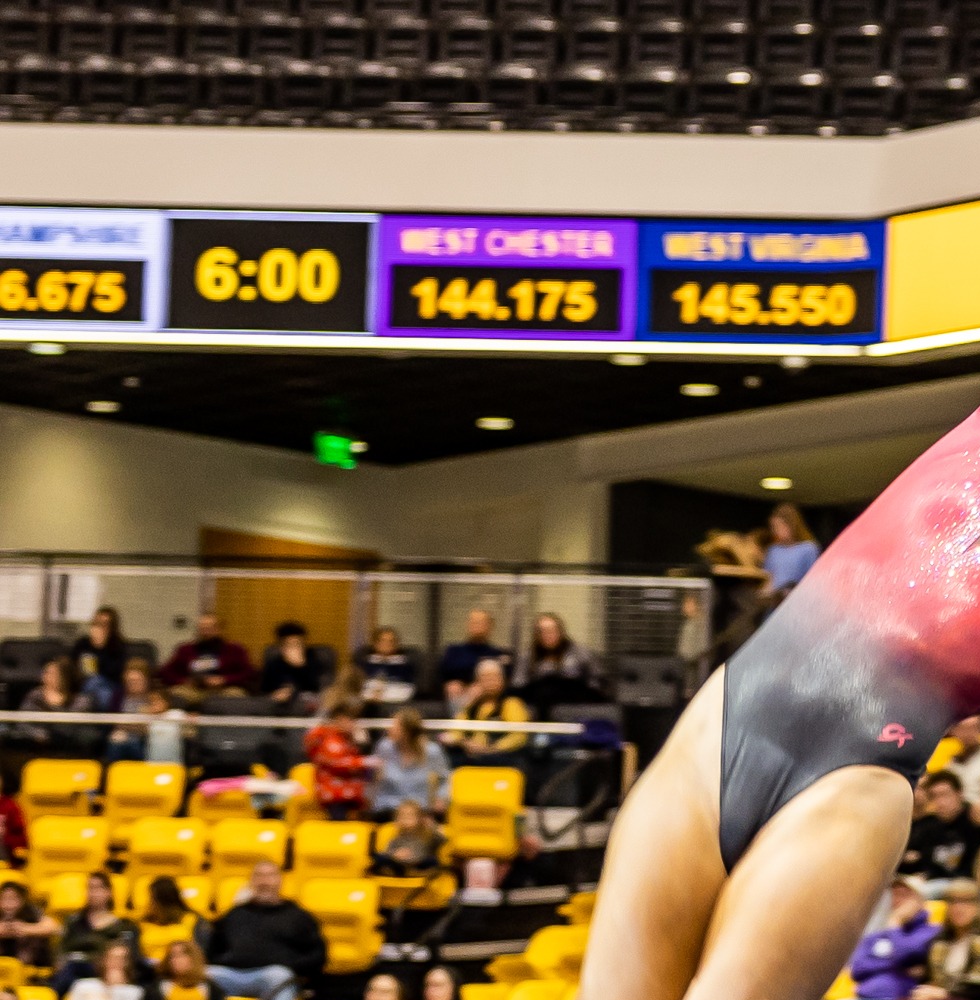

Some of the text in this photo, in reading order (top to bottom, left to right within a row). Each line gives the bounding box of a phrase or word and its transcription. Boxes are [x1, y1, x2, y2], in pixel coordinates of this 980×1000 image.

[0, 225, 142, 244] AMPSHIRE
[401, 228, 614, 258] WEST CHESTER
[662, 232, 870, 263] WEST VIRGINIA
[0, 268, 127, 313] 6.675
[195, 246, 341, 303] 6:00
[409, 276, 598, 322] 144.175
[671, 281, 857, 326] 145.550
